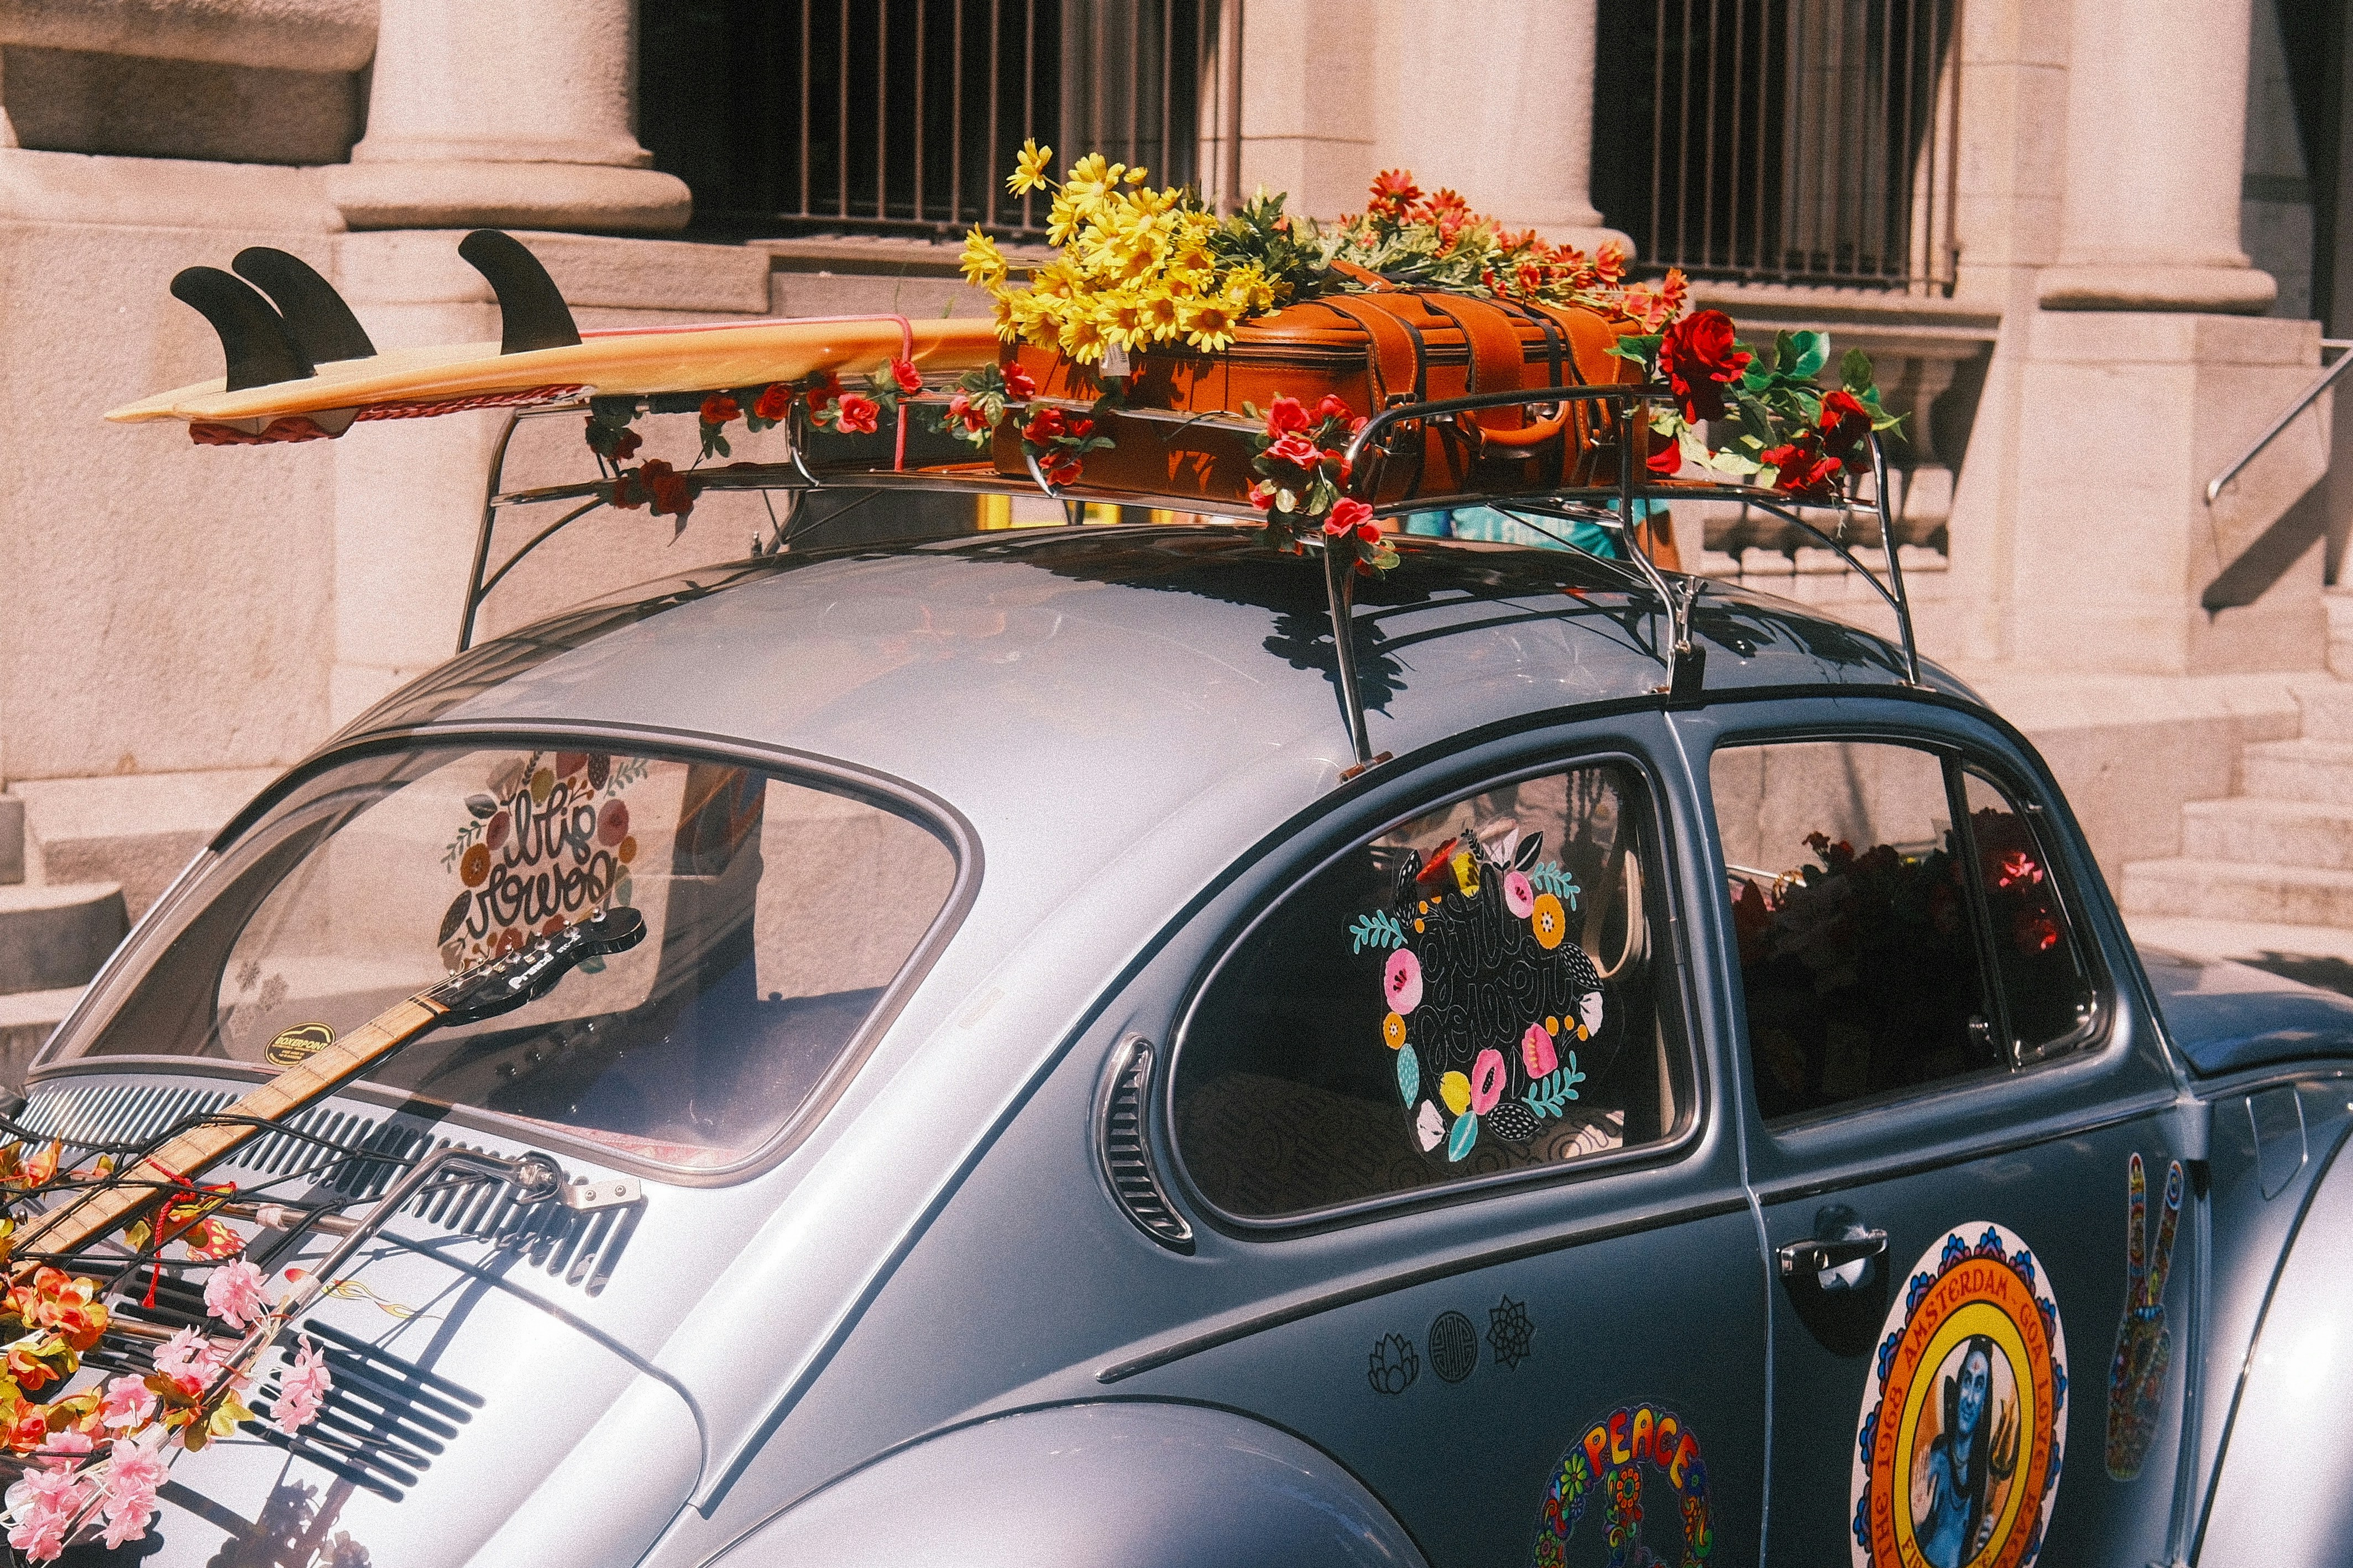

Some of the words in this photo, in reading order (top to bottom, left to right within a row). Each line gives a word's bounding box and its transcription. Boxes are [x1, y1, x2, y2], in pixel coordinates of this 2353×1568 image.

[1878, 1386, 1903, 1468] 1968
[1906, 1268, 2008, 1371] AMSTERDAM
[2020, 1304, 2044, 1366] GOA
[2035, 1380, 2050, 1471] LOVE
[1583, 1408, 1699, 1490] PEACE
